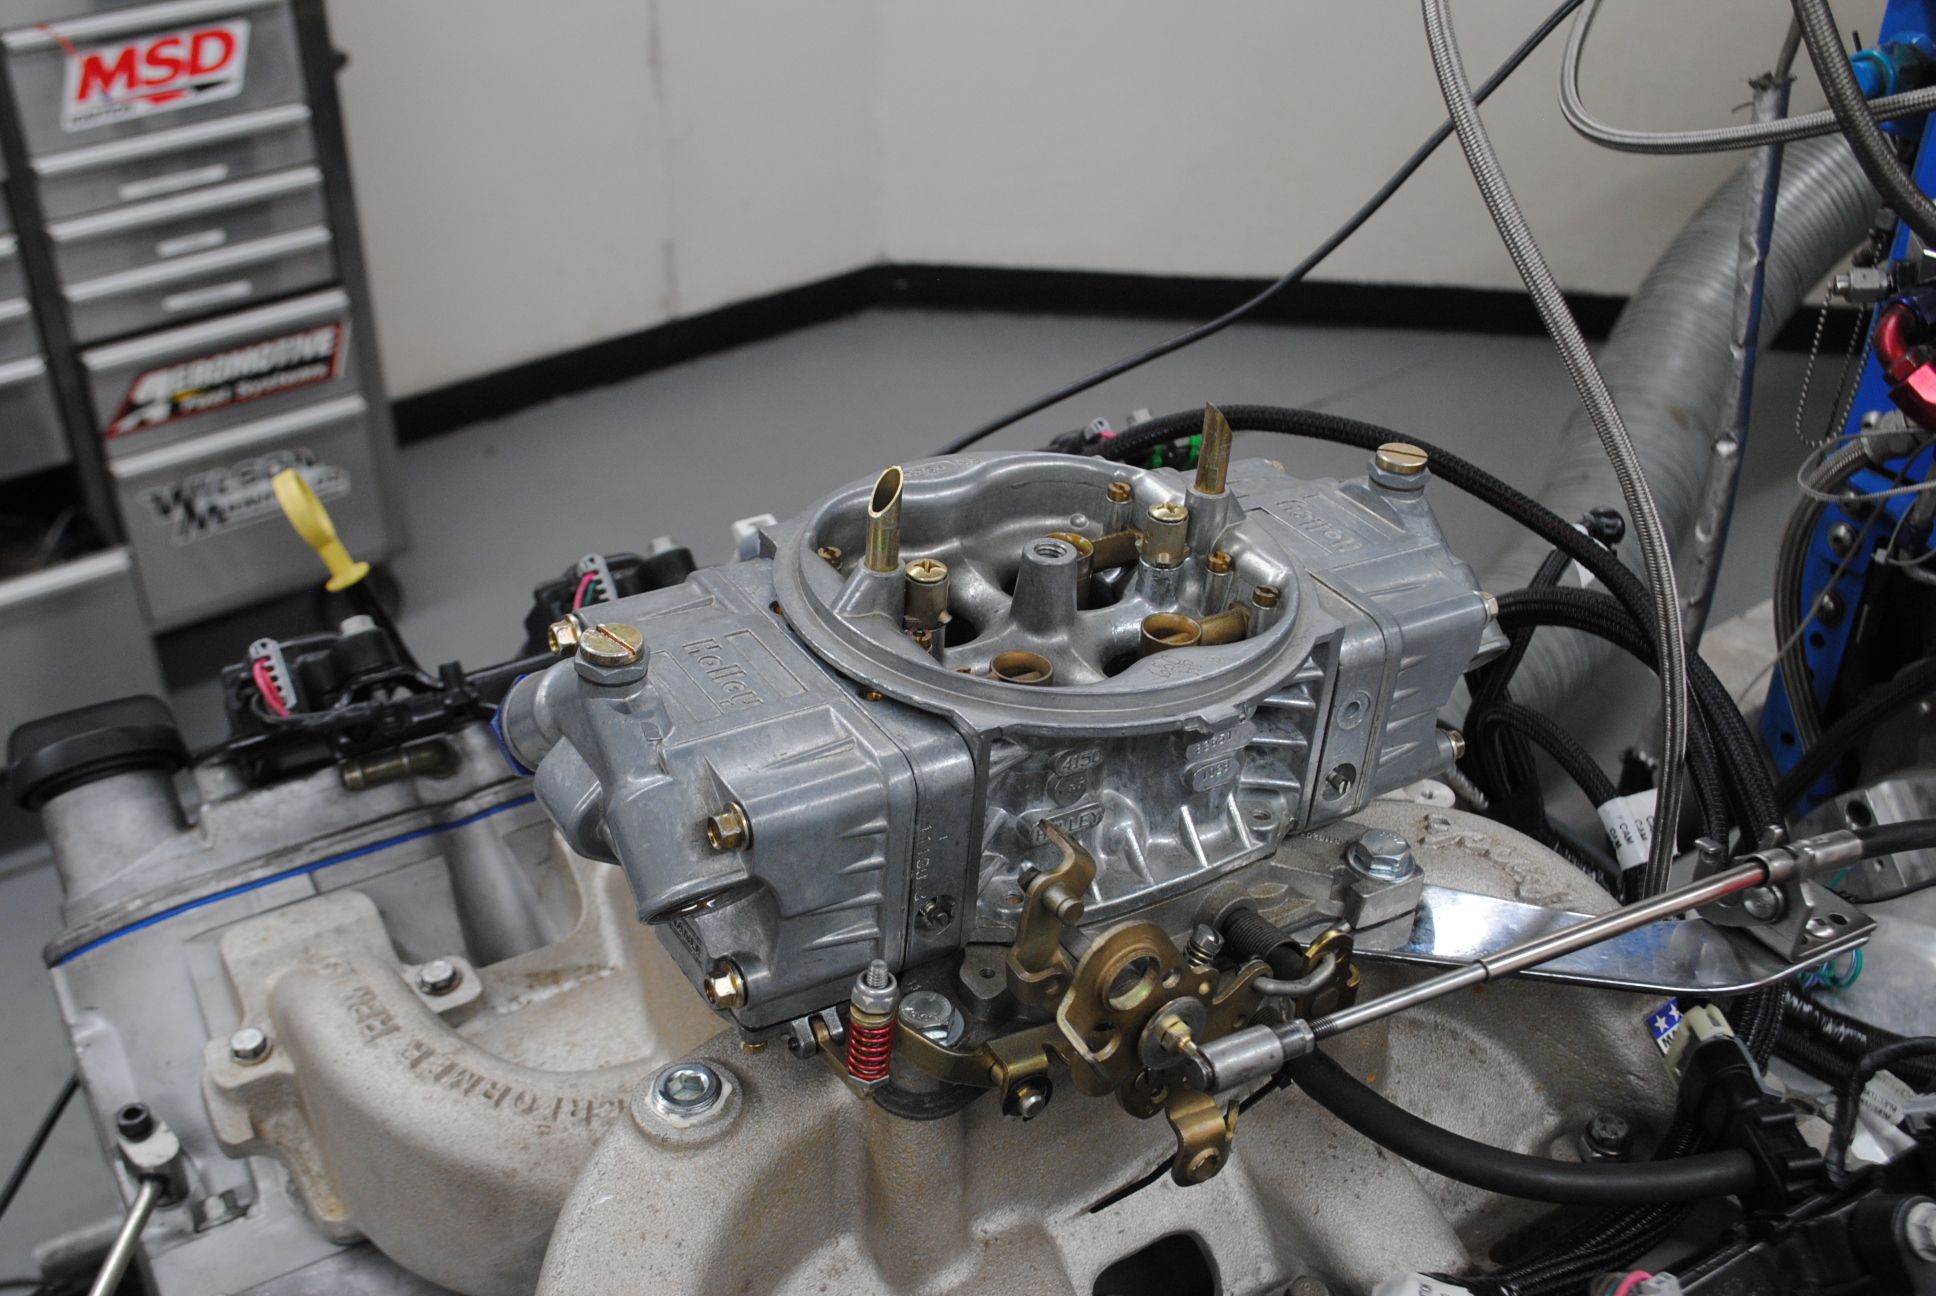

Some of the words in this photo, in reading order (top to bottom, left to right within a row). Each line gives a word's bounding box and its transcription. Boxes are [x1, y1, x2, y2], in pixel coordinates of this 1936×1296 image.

[77, 28, 236, 102] MSD
[682, 637, 765, 710] Holley
[1061, 746, 1102, 771] 4150
